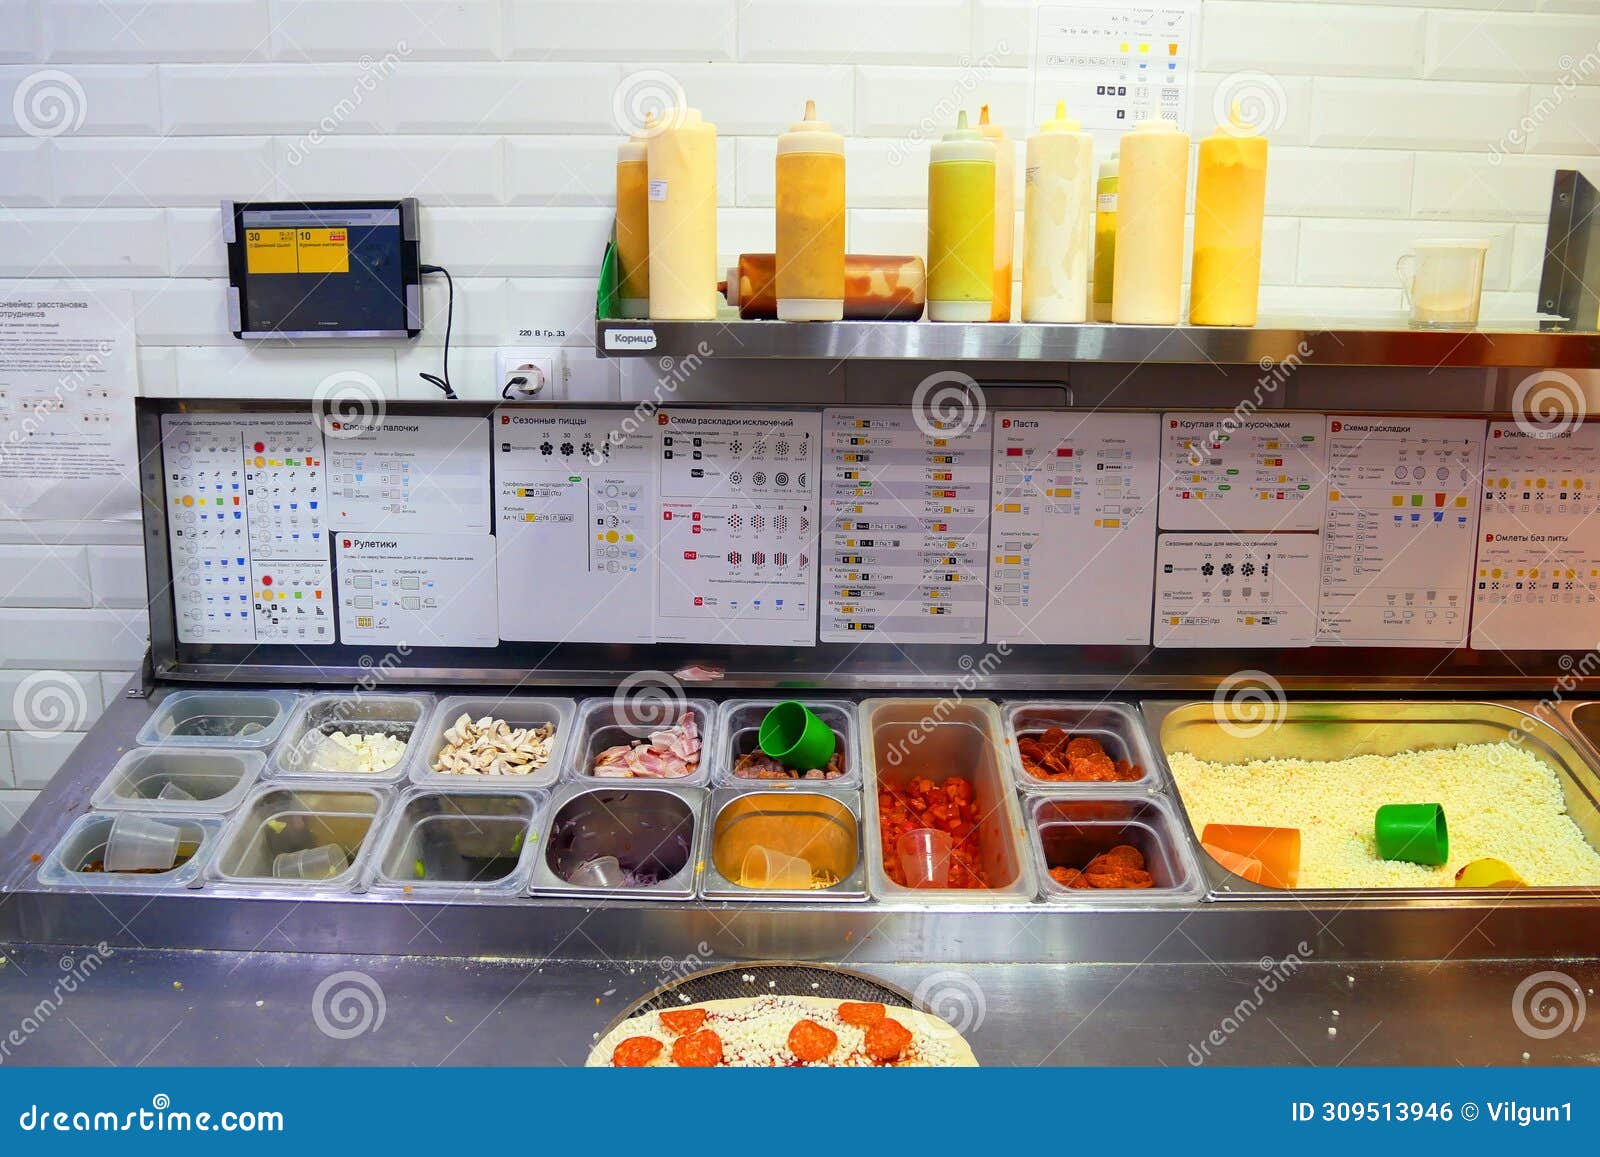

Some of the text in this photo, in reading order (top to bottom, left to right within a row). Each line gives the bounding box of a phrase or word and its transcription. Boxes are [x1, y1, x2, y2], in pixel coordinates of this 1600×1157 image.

[248, 232, 261, 241] 30
[300, 231, 311, 241] 10
[519, 329, 532, 337] 220
[615, 333, 653, 344] Корица
[512, 416, 587, 426] Сезонные пиццы
[670, 416, 794, 427] Схема раскладки исключений
[1012, 419, 1039, 428] Паста
[1180, 420, 1214, 429] Круглая
[1245, 421, 1291, 429] кусочками
[384, 424, 419, 432] палочки
[1343, 423, 1411, 433] Схема раскладки
[1495, 534, 1528, 542] Омлеты
[354, 539, 398, 549] Рулетики
